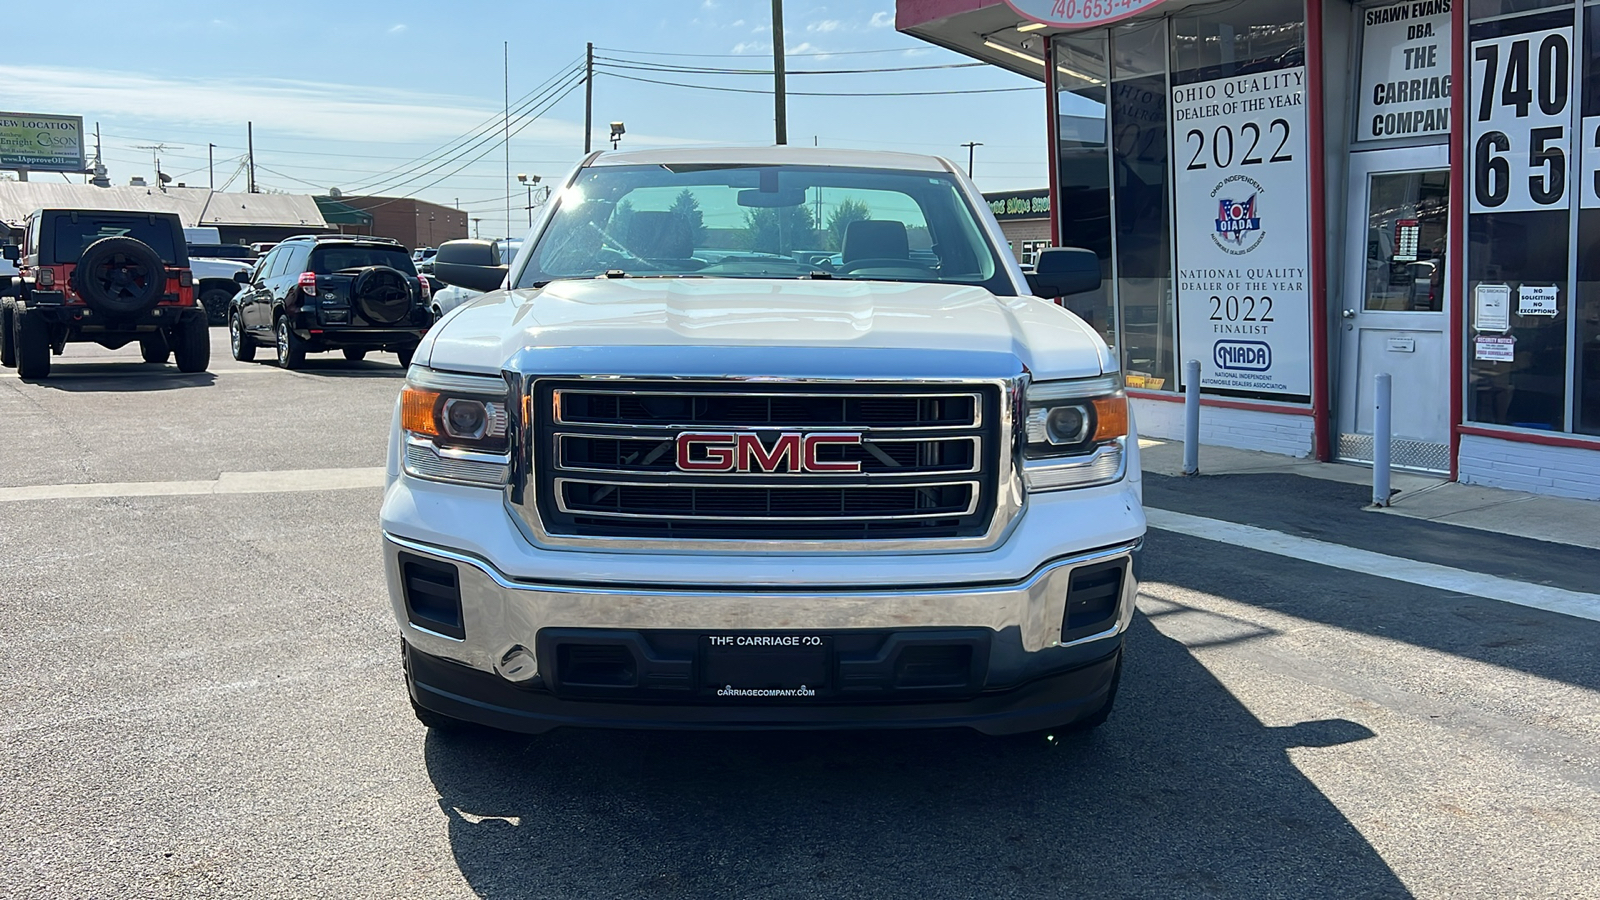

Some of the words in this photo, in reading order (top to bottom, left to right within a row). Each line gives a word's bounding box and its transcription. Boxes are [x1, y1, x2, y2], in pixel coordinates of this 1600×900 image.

[1366, 4, 1409, 26] SHAWN
[1407, 22, 1435, 40] DBA.
[1404, 45, 1437, 70] THE
[1174, 85, 1216, 104] OHIO
[1224, 71, 1303, 98] QUALITY
[1476, 34, 1568, 122] 740
[1373, 75, 1452, 106] CARRIAG
[1176, 104, 1220, 121] DEALER
[1222, 102, 1238, 115] OF
[1241, 98, 1264, 112] THE
[1268, 93, 1302, 108] YEAR
[22, 121, 76, 130] LOCATION
[1372, 108, 1452, 136] COMPAN
[1186, 118, 1292, 170] 2022
[1210, 182, 1223, 198] OHIO
[1224, 175, 1265, 194] INDEPENDENT
[1221, 219, 1253, 231] OIADA
[1180, 269, 1241, 278] NATIONAL
[1247, 268, 1304, 280] QUALITY
[1182, 282, 1222, 291] DEALER
[1227, 282, 1240, 291] OF
[1246, 282, 1267, 291] THE
[1272, 282, 1303, 291] YEAR
[1210, 296, 1274, 322] 2022
[1214, 324, 1268, 334] FINALIST
[1218, 346, 1266, 364] NIADA
[676, 432, 862, 472] GMC
[736, 636, 800, 646] CARRIAGE
